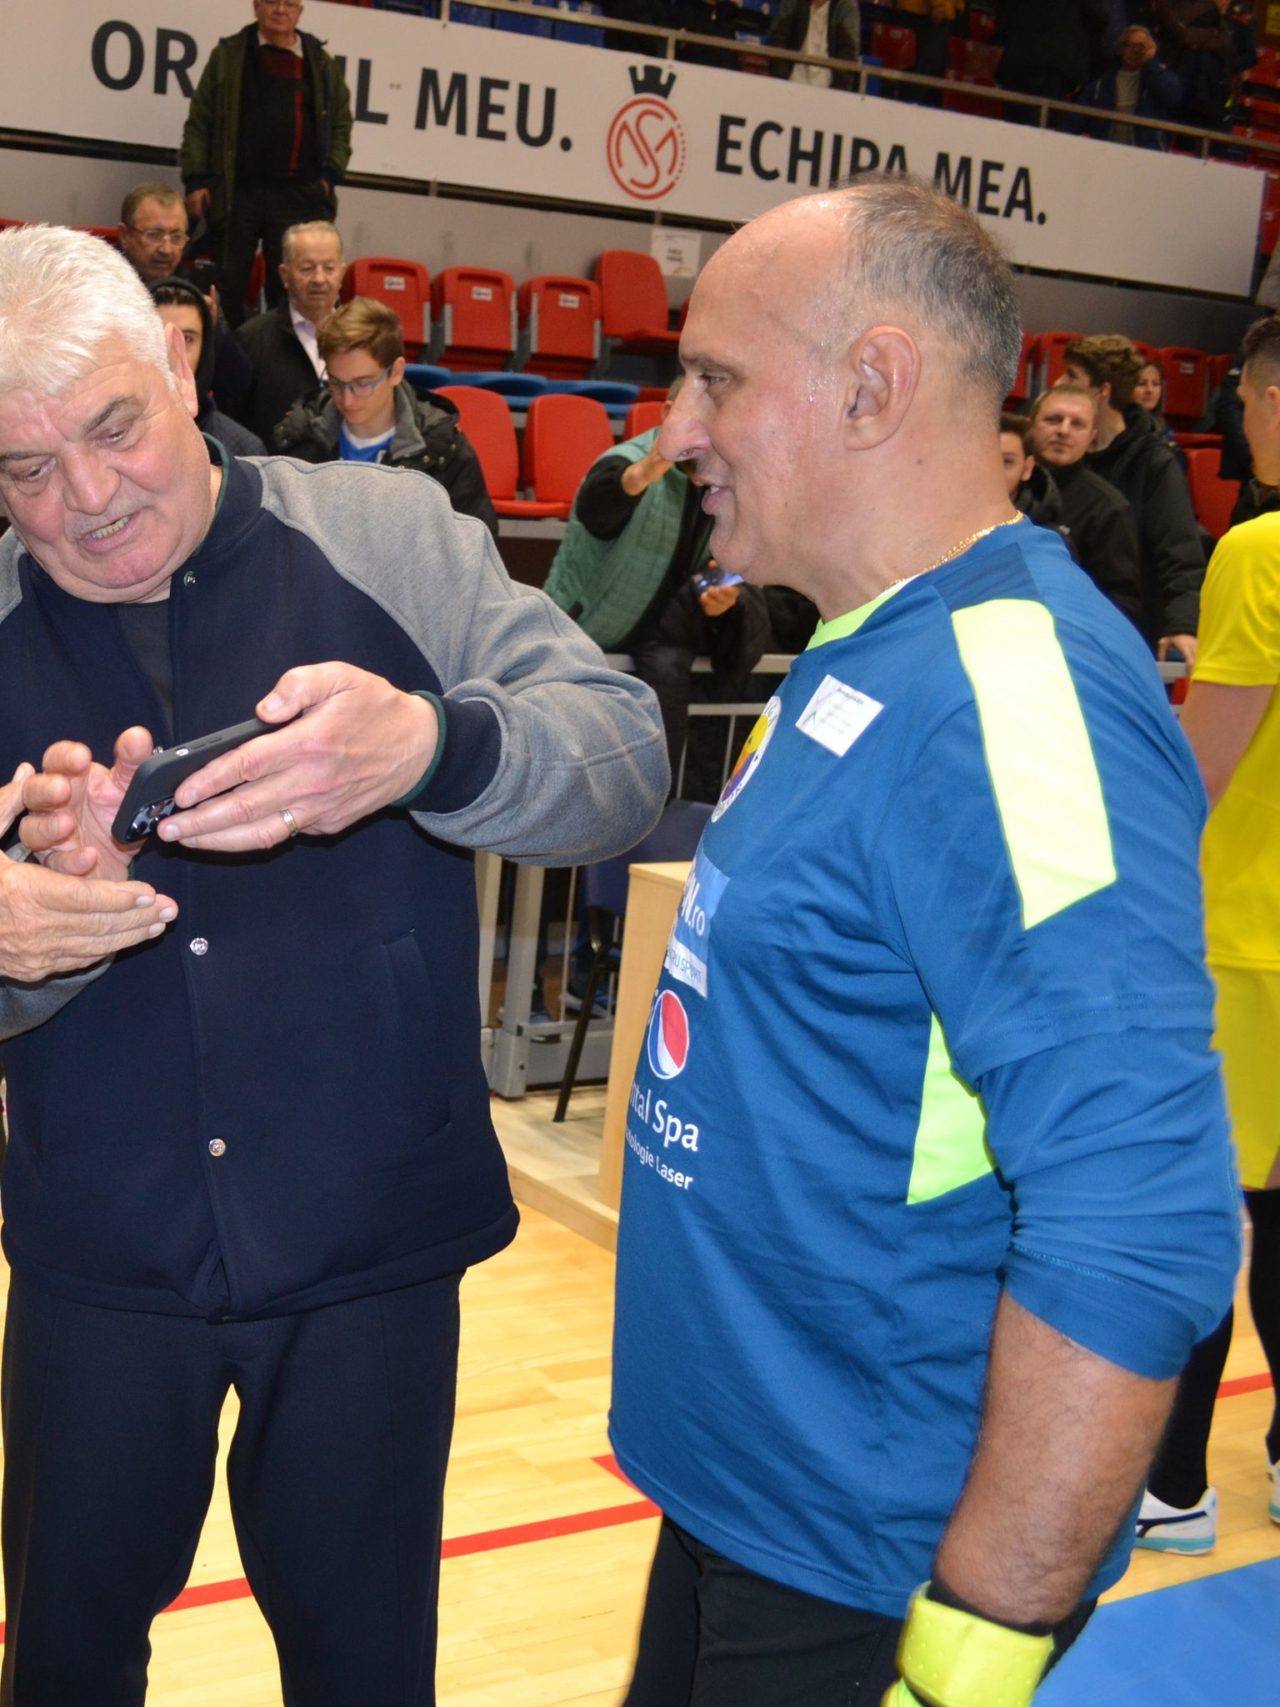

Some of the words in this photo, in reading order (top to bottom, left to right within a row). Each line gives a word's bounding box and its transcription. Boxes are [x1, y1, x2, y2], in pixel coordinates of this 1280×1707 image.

[90, 19, 389, 125] ORL
[414, 66, 573, 152] MEU.
[933, 151, 1047, 225] MEA.
[652, 1099, 700, 1152] Spa
[656, 1155, 694, 1190] Laser
